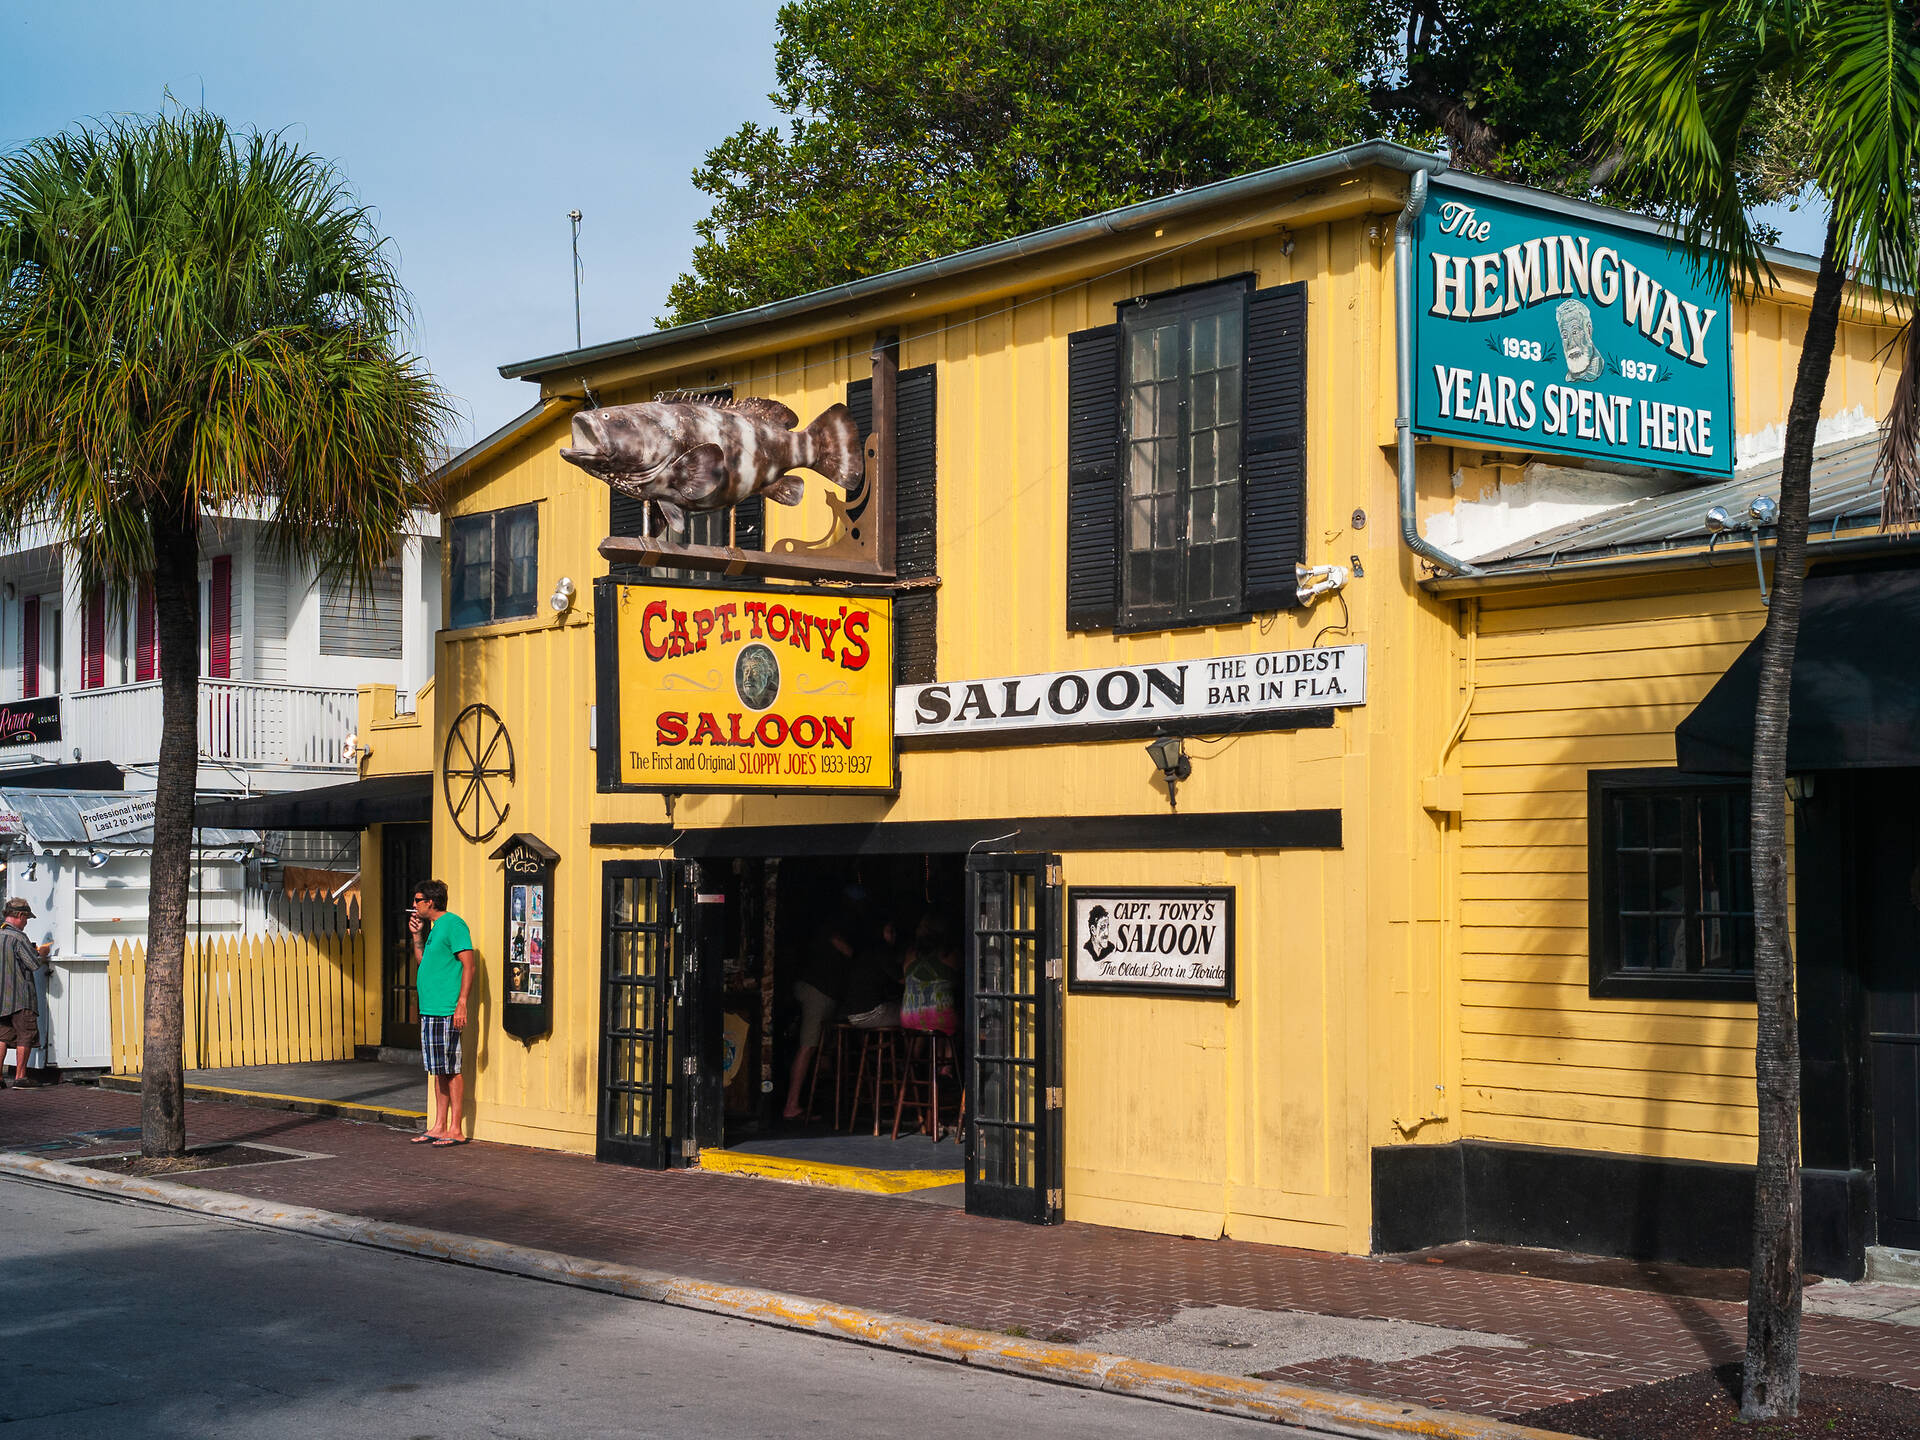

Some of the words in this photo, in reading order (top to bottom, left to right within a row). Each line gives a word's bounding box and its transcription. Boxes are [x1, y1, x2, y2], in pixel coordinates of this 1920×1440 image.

[1440, 201, 1491, 242] The
[1429, 235, 1717, 368] HEMINGWAY
[1502, 337, 1542, 362] 1933
[1620, 358, 1657, 383] 1937
[1433, 364, 1537, 431] YEARS
[1542, 383, 1632, 446] SPENT
[1638, 399, 1713, 457] HERE
[640, 600, 740, 662] CAPT.
[744, 601, 870, 671] TONY'S
[914, 664, 1190, 726] SALOON
[1207, 660, 1246, 681] THE
[1255, 651, 1346, 675] OLDEST
[1207, 683, 1250, 705] BAR
[1259, 681, 1284, 701] IN
[1294, 676, 1348, 699] FLA.
[37, 714, 58, 724] LOUNGE
[656, 711, 854, 749] SALOON
[630, 751, 649, 770] The
[651, 752, 673, 770] First
[675, 753, 695, 770] and
[697, 754, 736, 774] Original
[738, 753, 780, 775] SLOPPY
[821, 755, 872, 774] 1933-1937
[82, 804, 131, 824] Professional
[131, 799, 156, 812] Henna
[94, 821, 113, 832] Last
[113, 818, 119, 827] 2
[119, 815, 128, 826] to
[128, 815, 134, 824] 3
[1113, 902, 1151, 920] CAPT.
[1115, 923, 1216, 956] SALOON
[1099, 961, 1116, 977] The
[1118, 962, 1149, 977] Oldest
[1150, 961, 1173, 978] Bar
[1176, 964, 1187, 977] in
[1188, 963, 1226, 980] Florida
